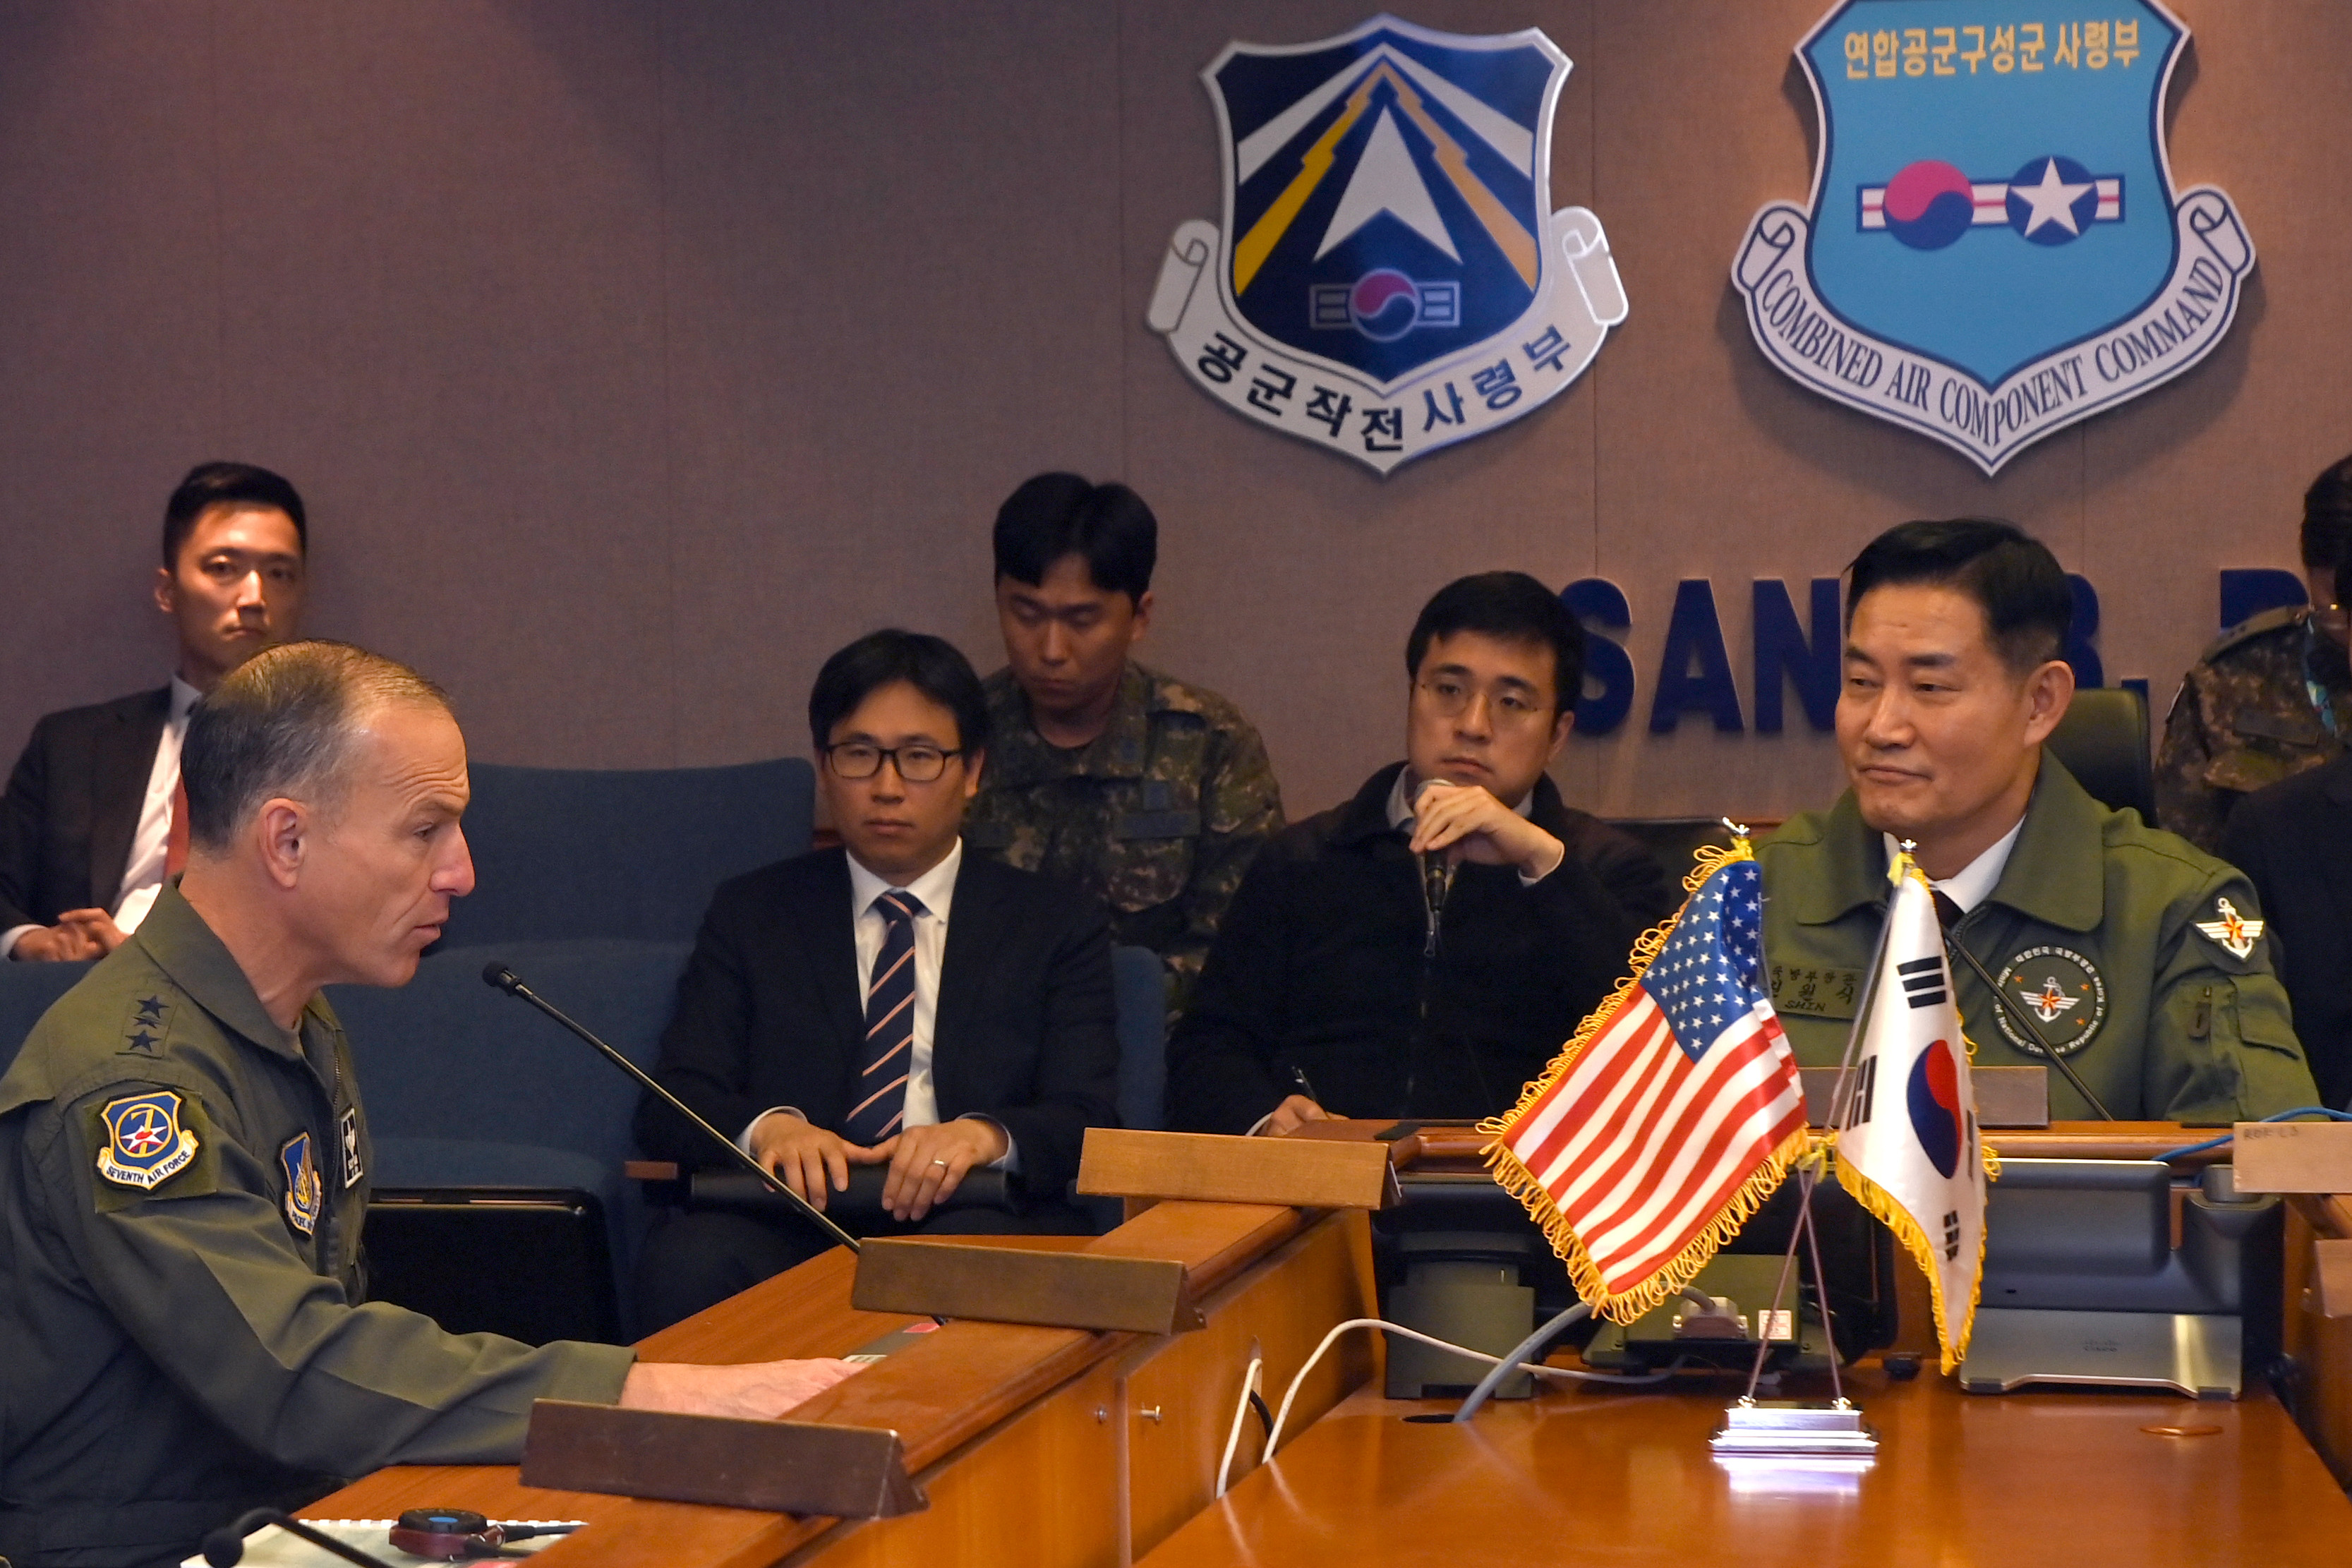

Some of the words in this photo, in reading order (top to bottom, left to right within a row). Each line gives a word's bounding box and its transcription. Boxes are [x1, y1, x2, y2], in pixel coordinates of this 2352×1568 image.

[1843, 22, 2046, 79] 연합공군구성군
[2052, 18, 2140, 69] 사령부
[1759, 267, 1884, 390] COMBINED
[1886, 361, 1930, 412] AIR
[1939, 358, 2087, 449] COMPONENT
[2094, 254, 2225, 382] COMMAND
[1197, 325, 1571, 453] 공군작전사령부
[1785, 1000, 1826, 1011] SHIN
[106, 1166, 145, 1183] SEVENTH
[147, 1168, 164, 1184] AIR
[163, 1150, 191, 1174] FORCE
